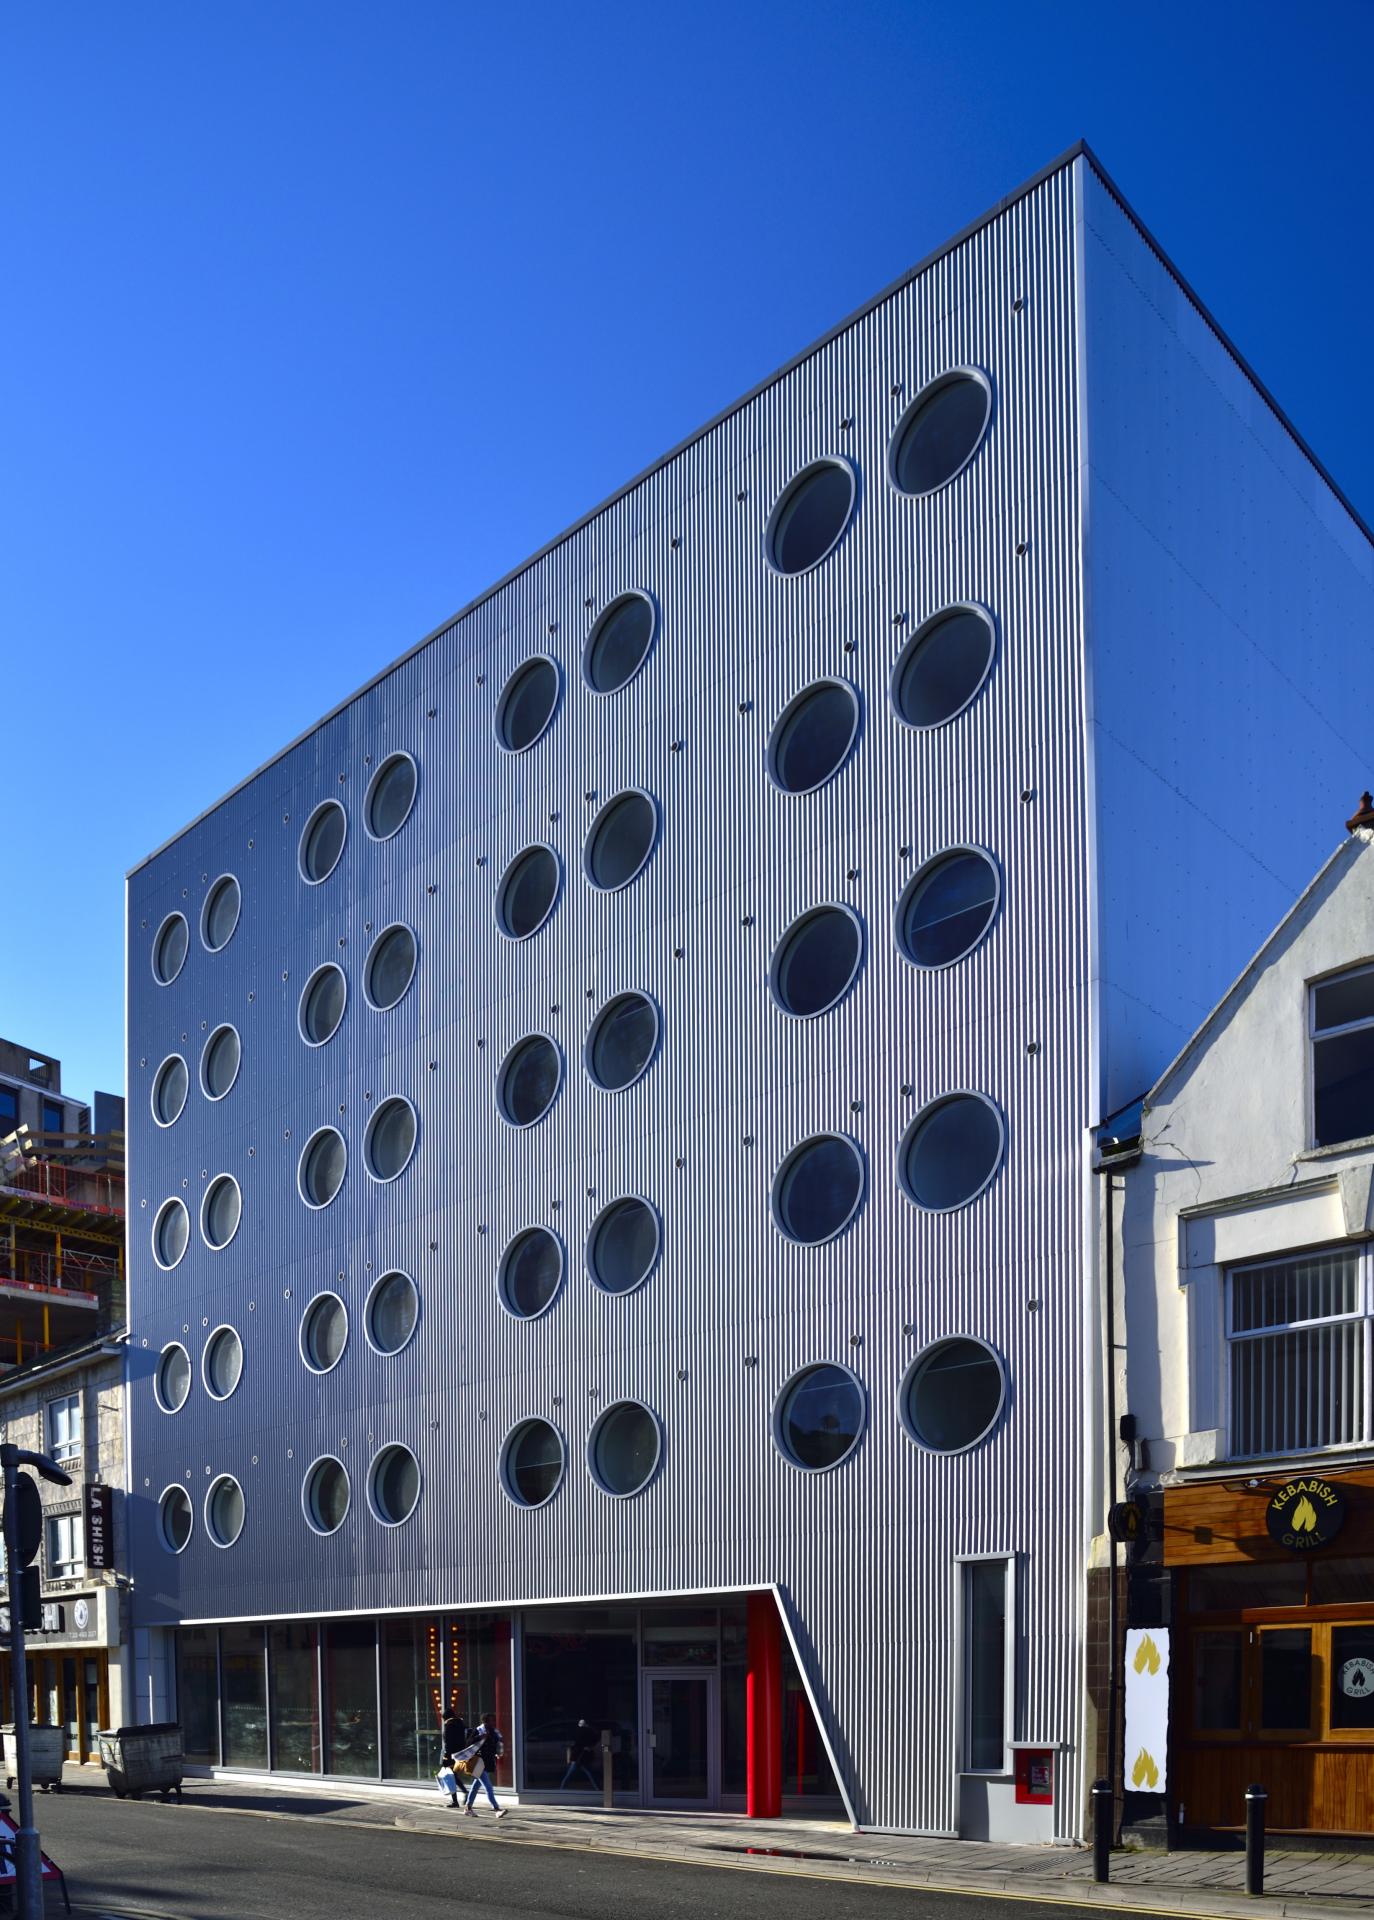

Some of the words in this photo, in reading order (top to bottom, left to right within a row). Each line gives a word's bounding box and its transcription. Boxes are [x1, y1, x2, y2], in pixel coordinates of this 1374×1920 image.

[90, 1487, 102, 1509] LA
[1272, 1480, 1338, 1510] KEBABISH
[91, 1514, 104, 1566] SHISH
[1281, 1532, 1326, 1549] GRILL
[1346, 1686, 1371, 1696] GRILL
